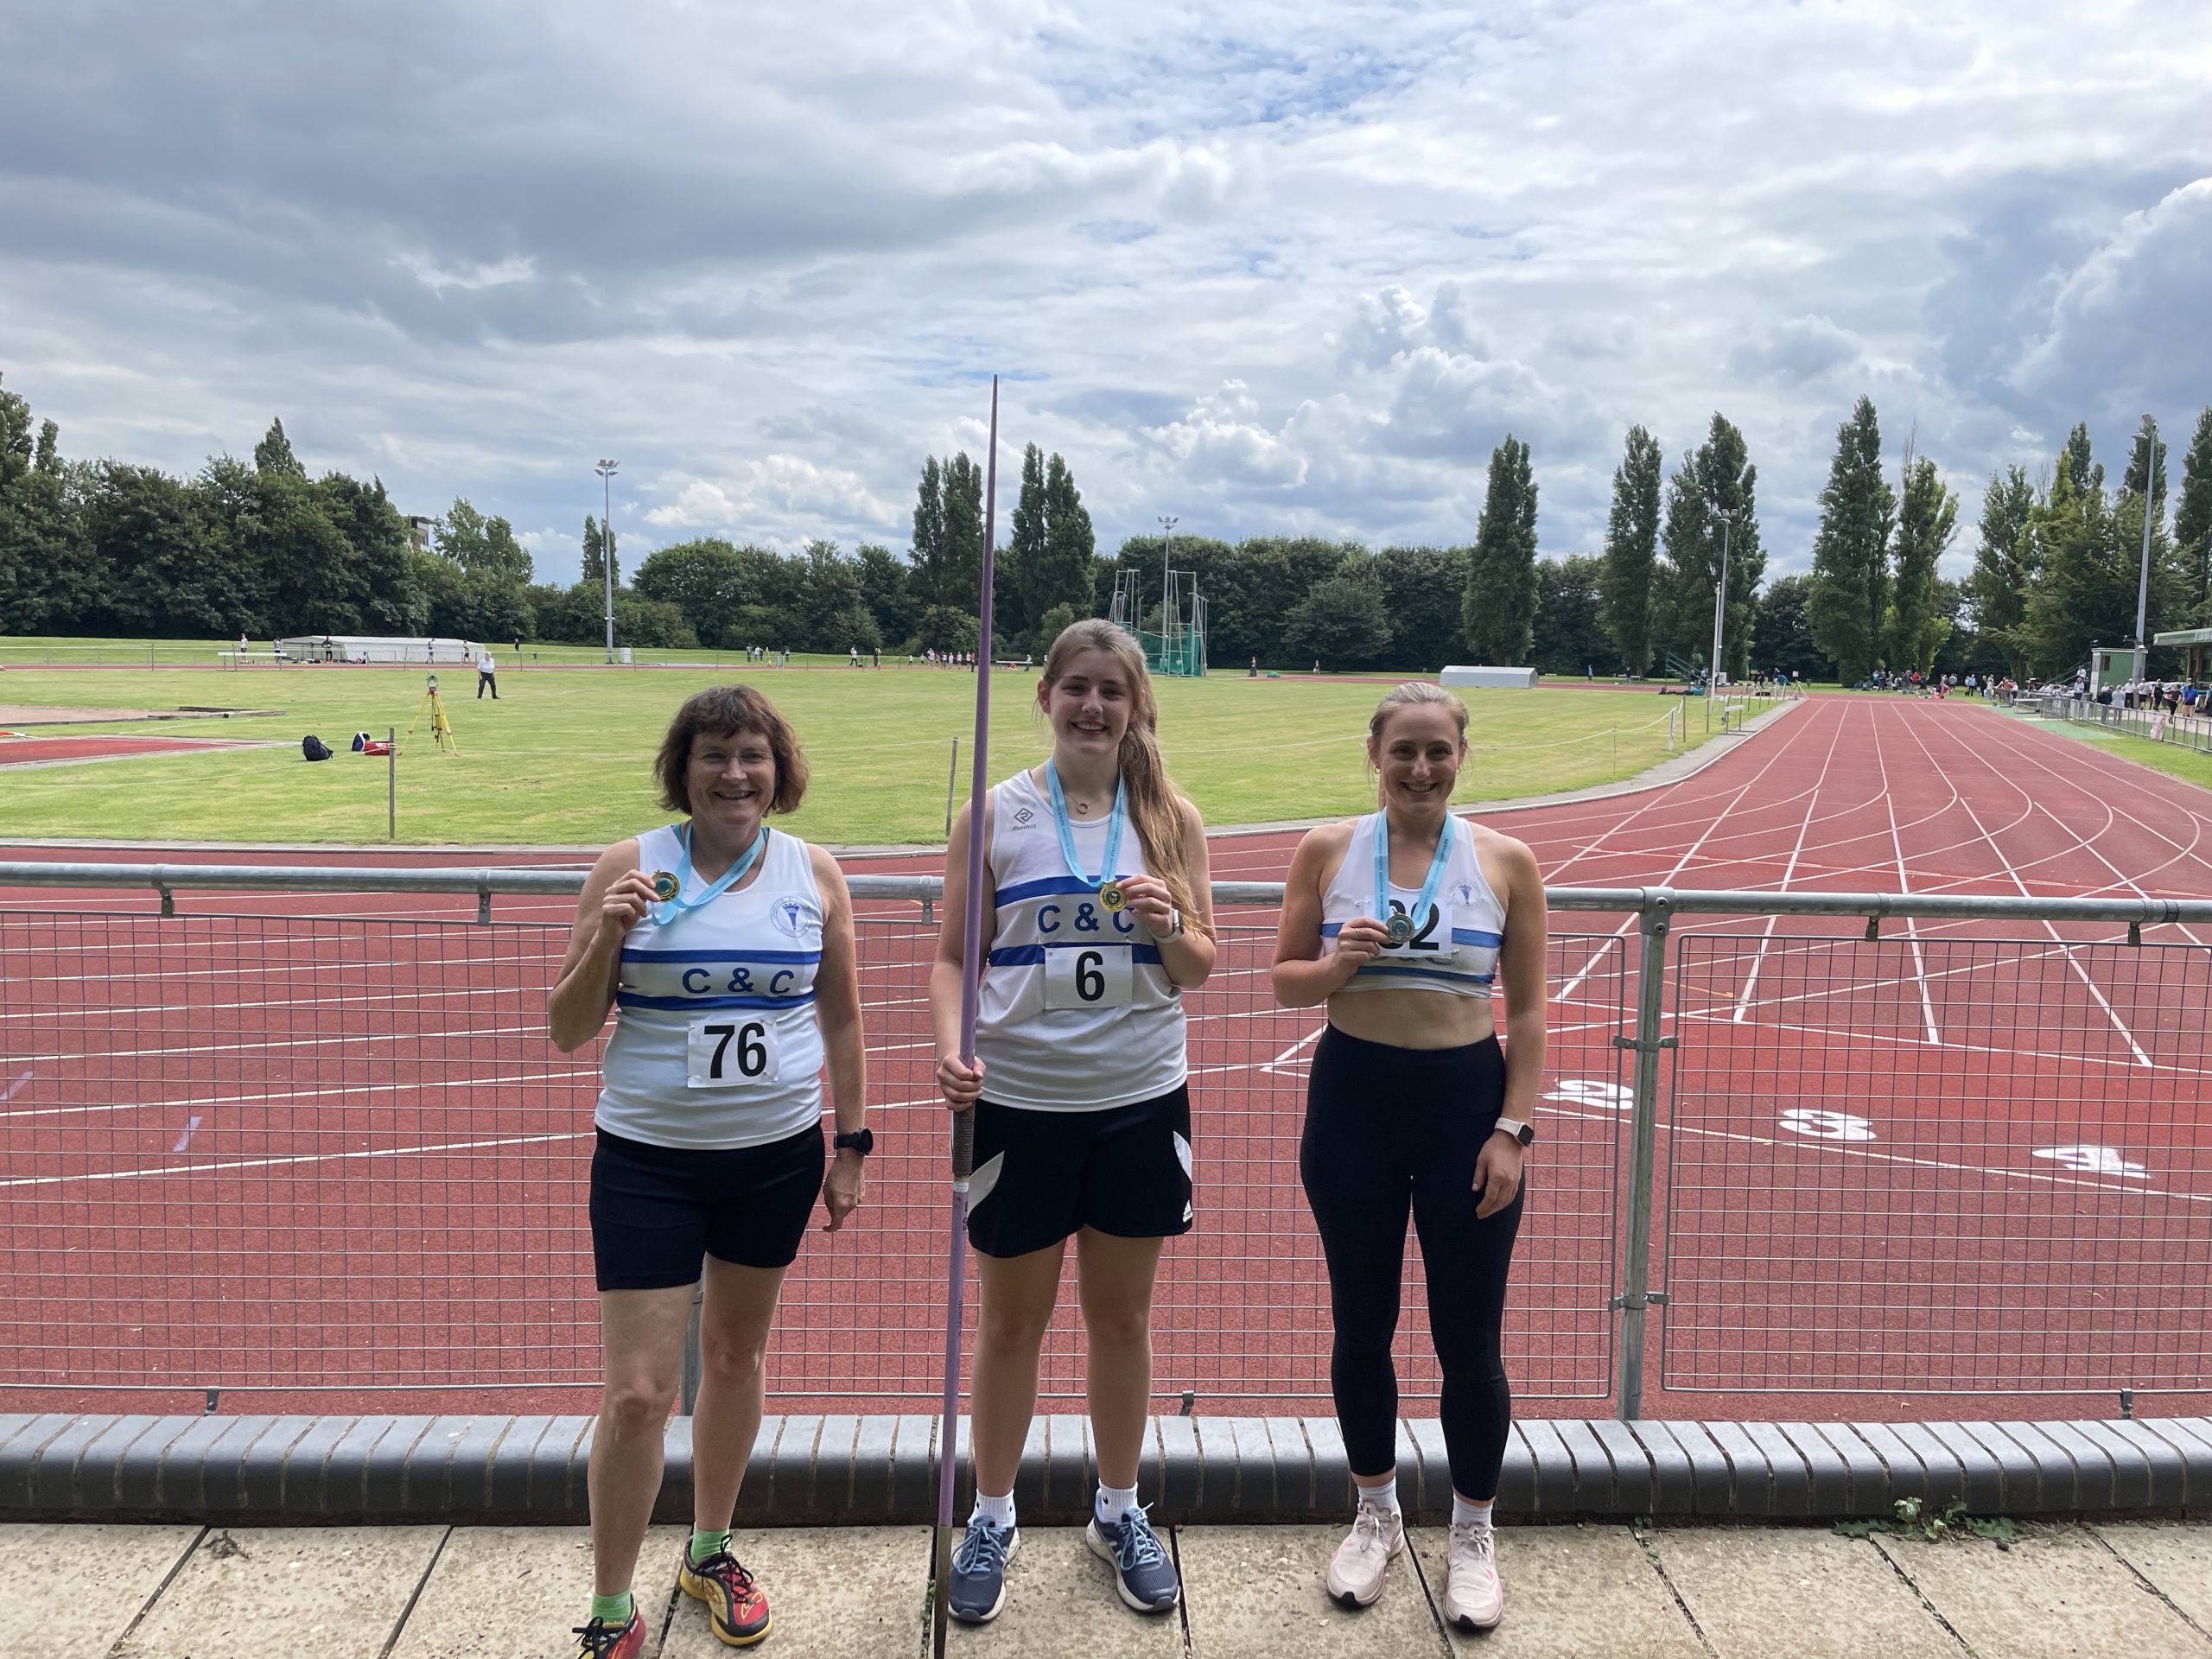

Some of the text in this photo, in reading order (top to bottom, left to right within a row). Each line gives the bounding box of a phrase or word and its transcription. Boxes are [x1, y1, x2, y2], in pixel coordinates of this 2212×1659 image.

[1012, 823, 1037, 832] Ronhill
[1038, 902, 1135, 934] C & C
[682, 967, 795, 995] C & C
[1075, 950, 1105, 1001] 6
[703, 1022, 767, 1080] 76
[1541, 1079, 1635, 1110] 2
[1778, 1109, 1878, 1141] 3
[2031, 1144, 2152, 1179] 4
